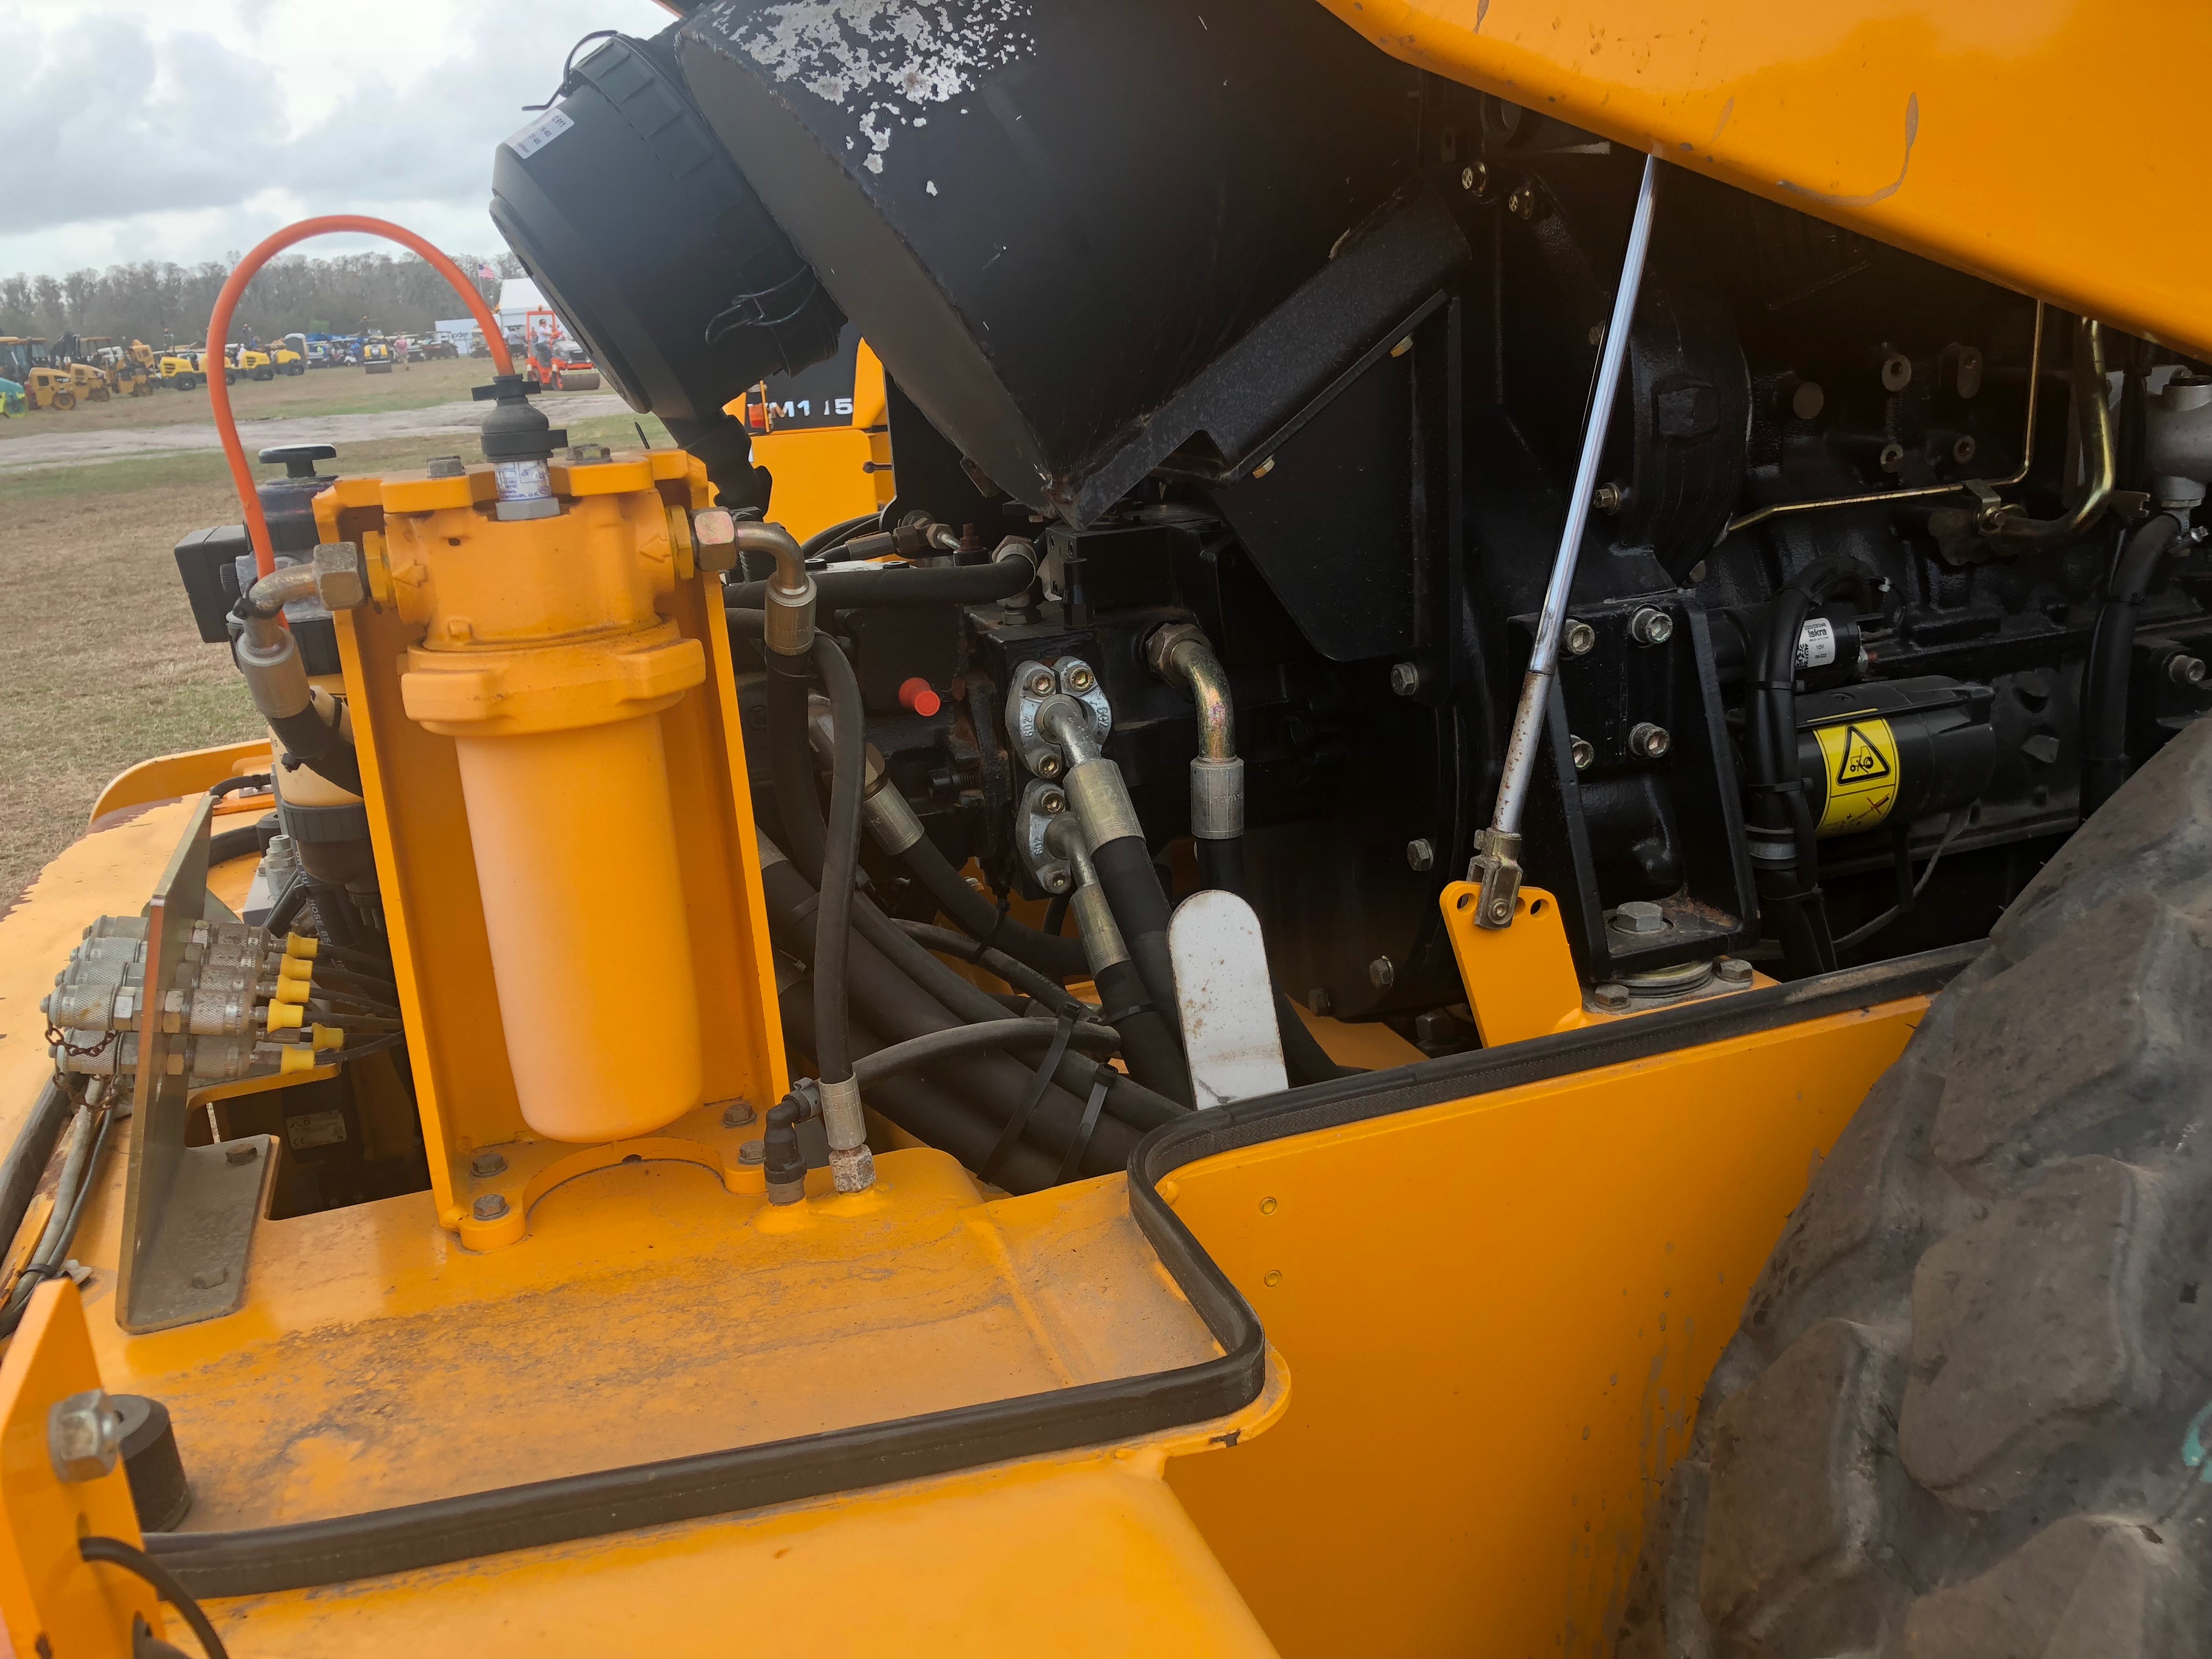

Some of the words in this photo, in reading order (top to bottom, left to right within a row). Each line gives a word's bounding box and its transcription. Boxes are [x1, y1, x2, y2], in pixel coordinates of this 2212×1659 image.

[1807, 628, 1827, 638] Iskra
[1022, 714, 1033, 737] 602
[309, 899, 324, 926] HOSE
[290, 1116, 311, 1128] JCB
